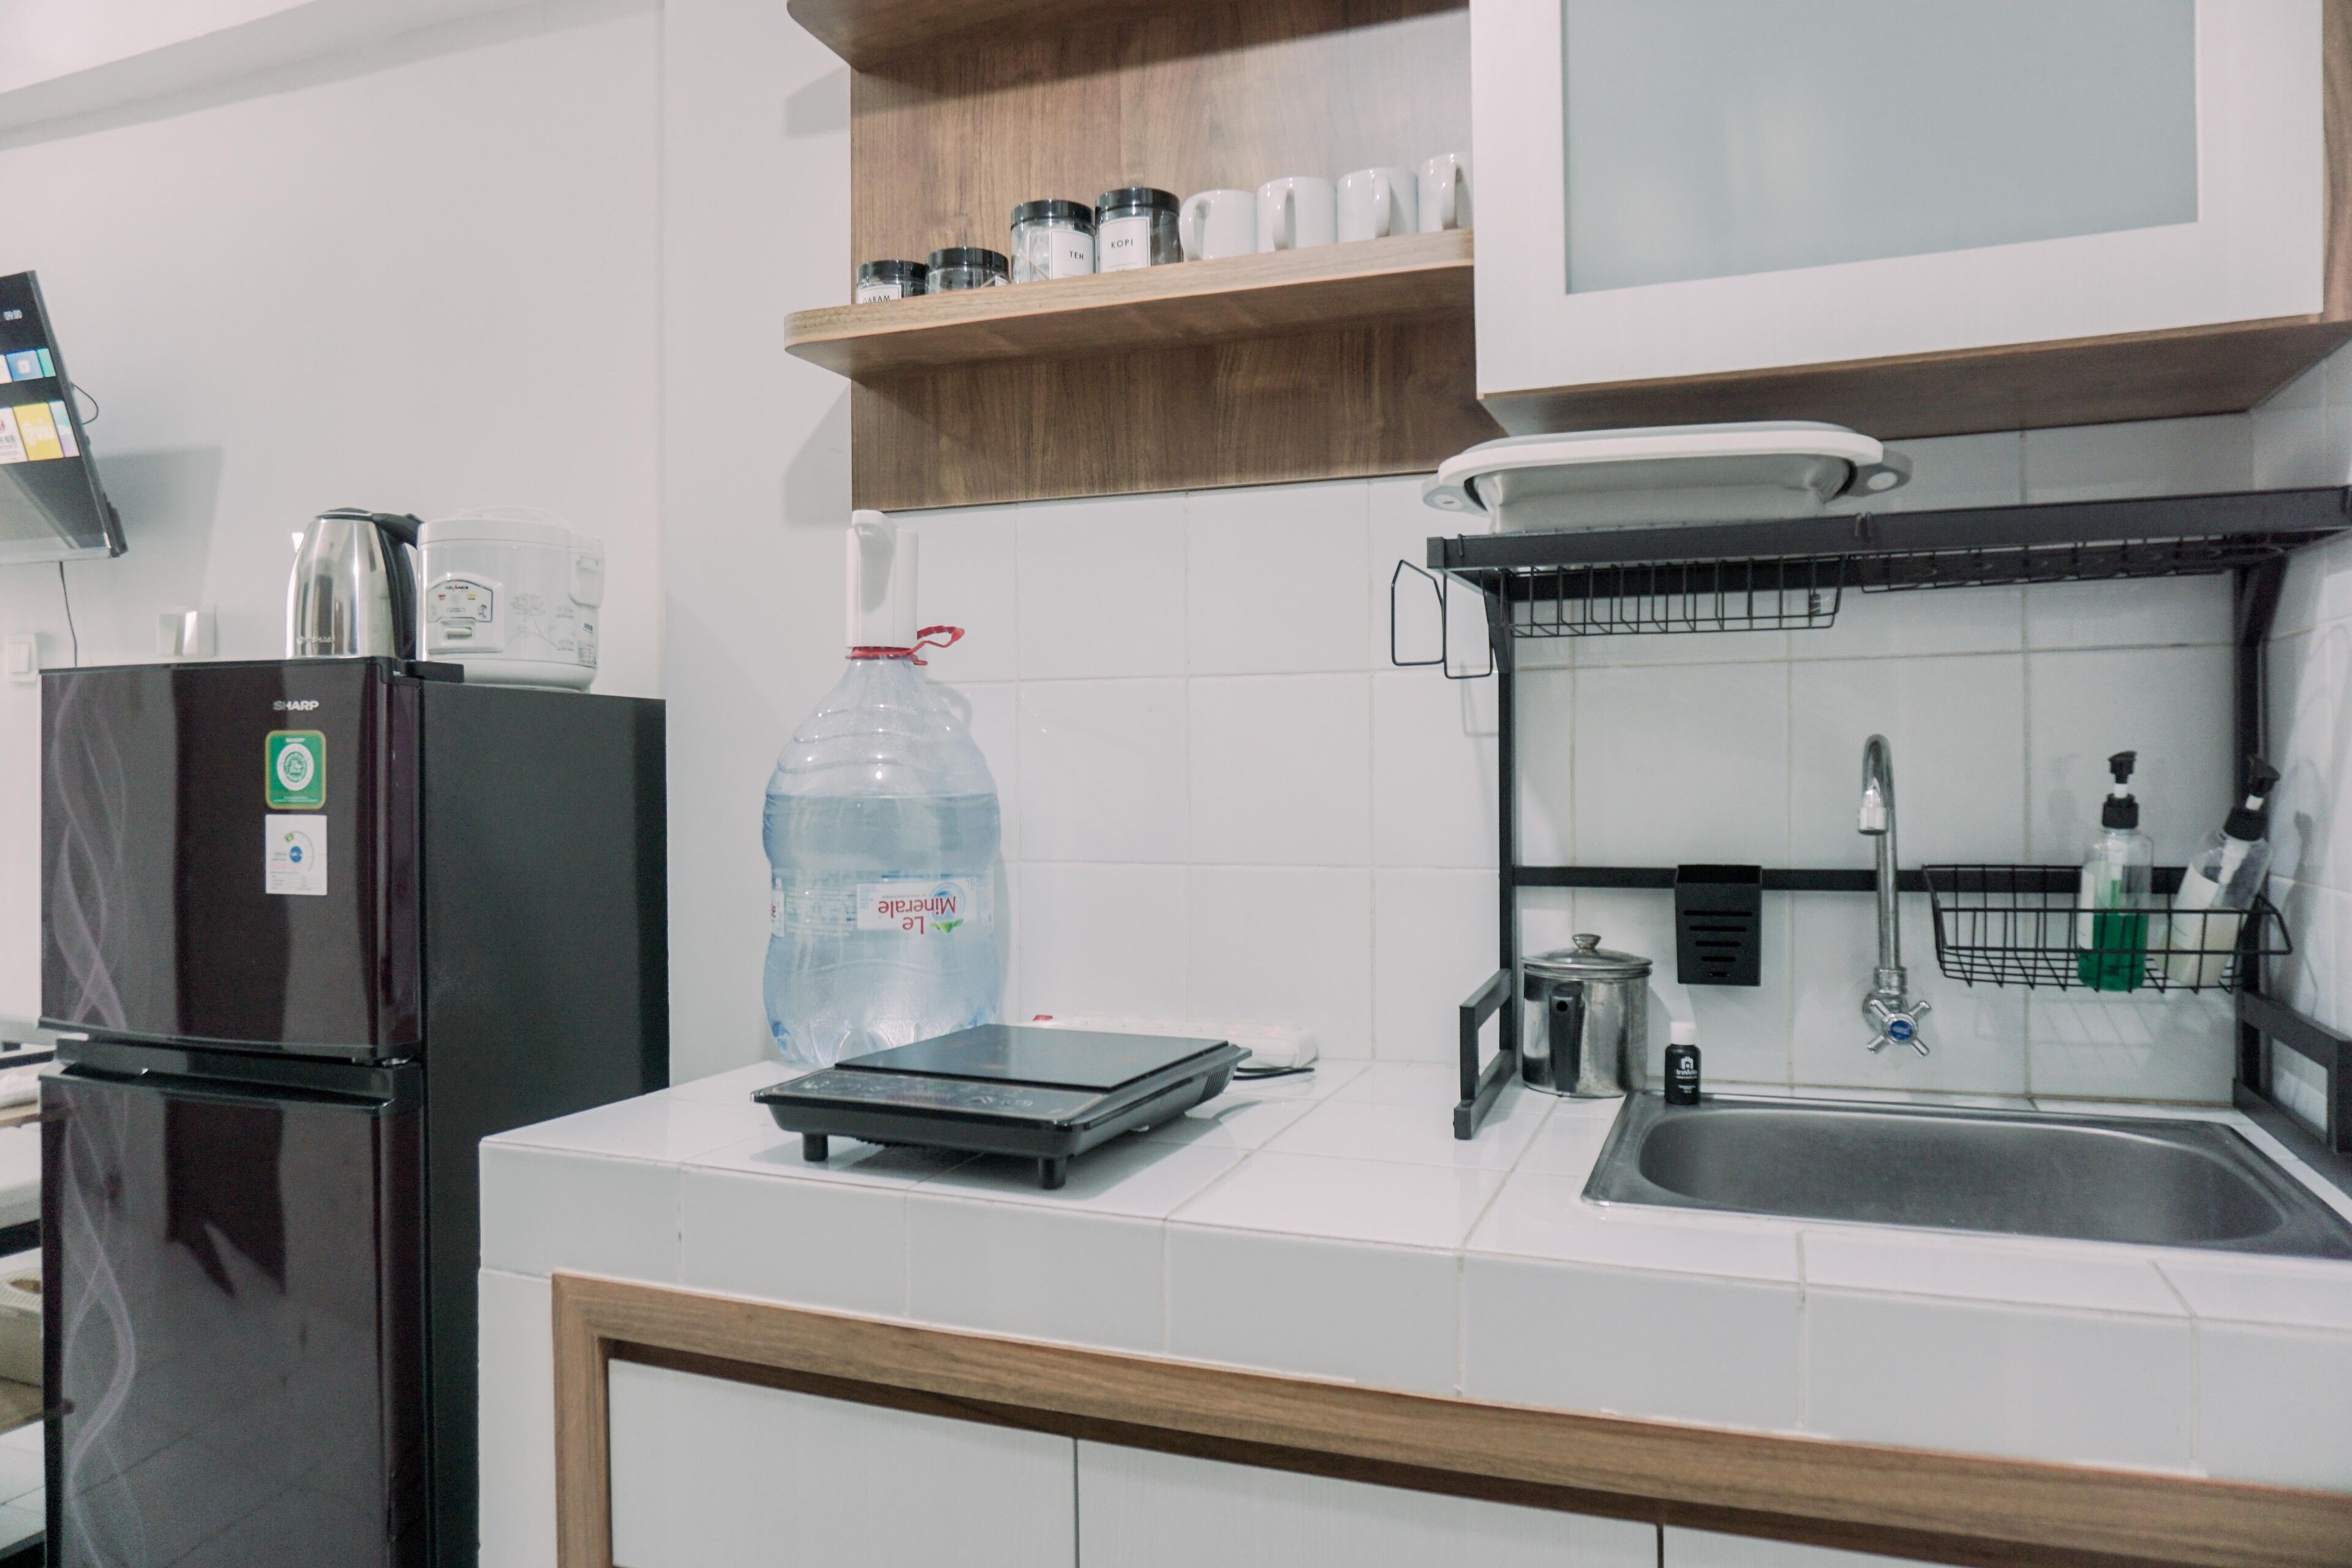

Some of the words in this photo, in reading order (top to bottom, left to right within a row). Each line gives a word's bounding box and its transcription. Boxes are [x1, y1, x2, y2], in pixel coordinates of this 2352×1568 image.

[1111, 238, 1133, 249] KOPI
[1069, 251, 1084, 260] TEH
[864, 295, 891, 304] GARAM
[273, 700, 319, 710] SHARP
[878, 896, 956, 918] Minerale
[902, 916, 924, 935] Le
